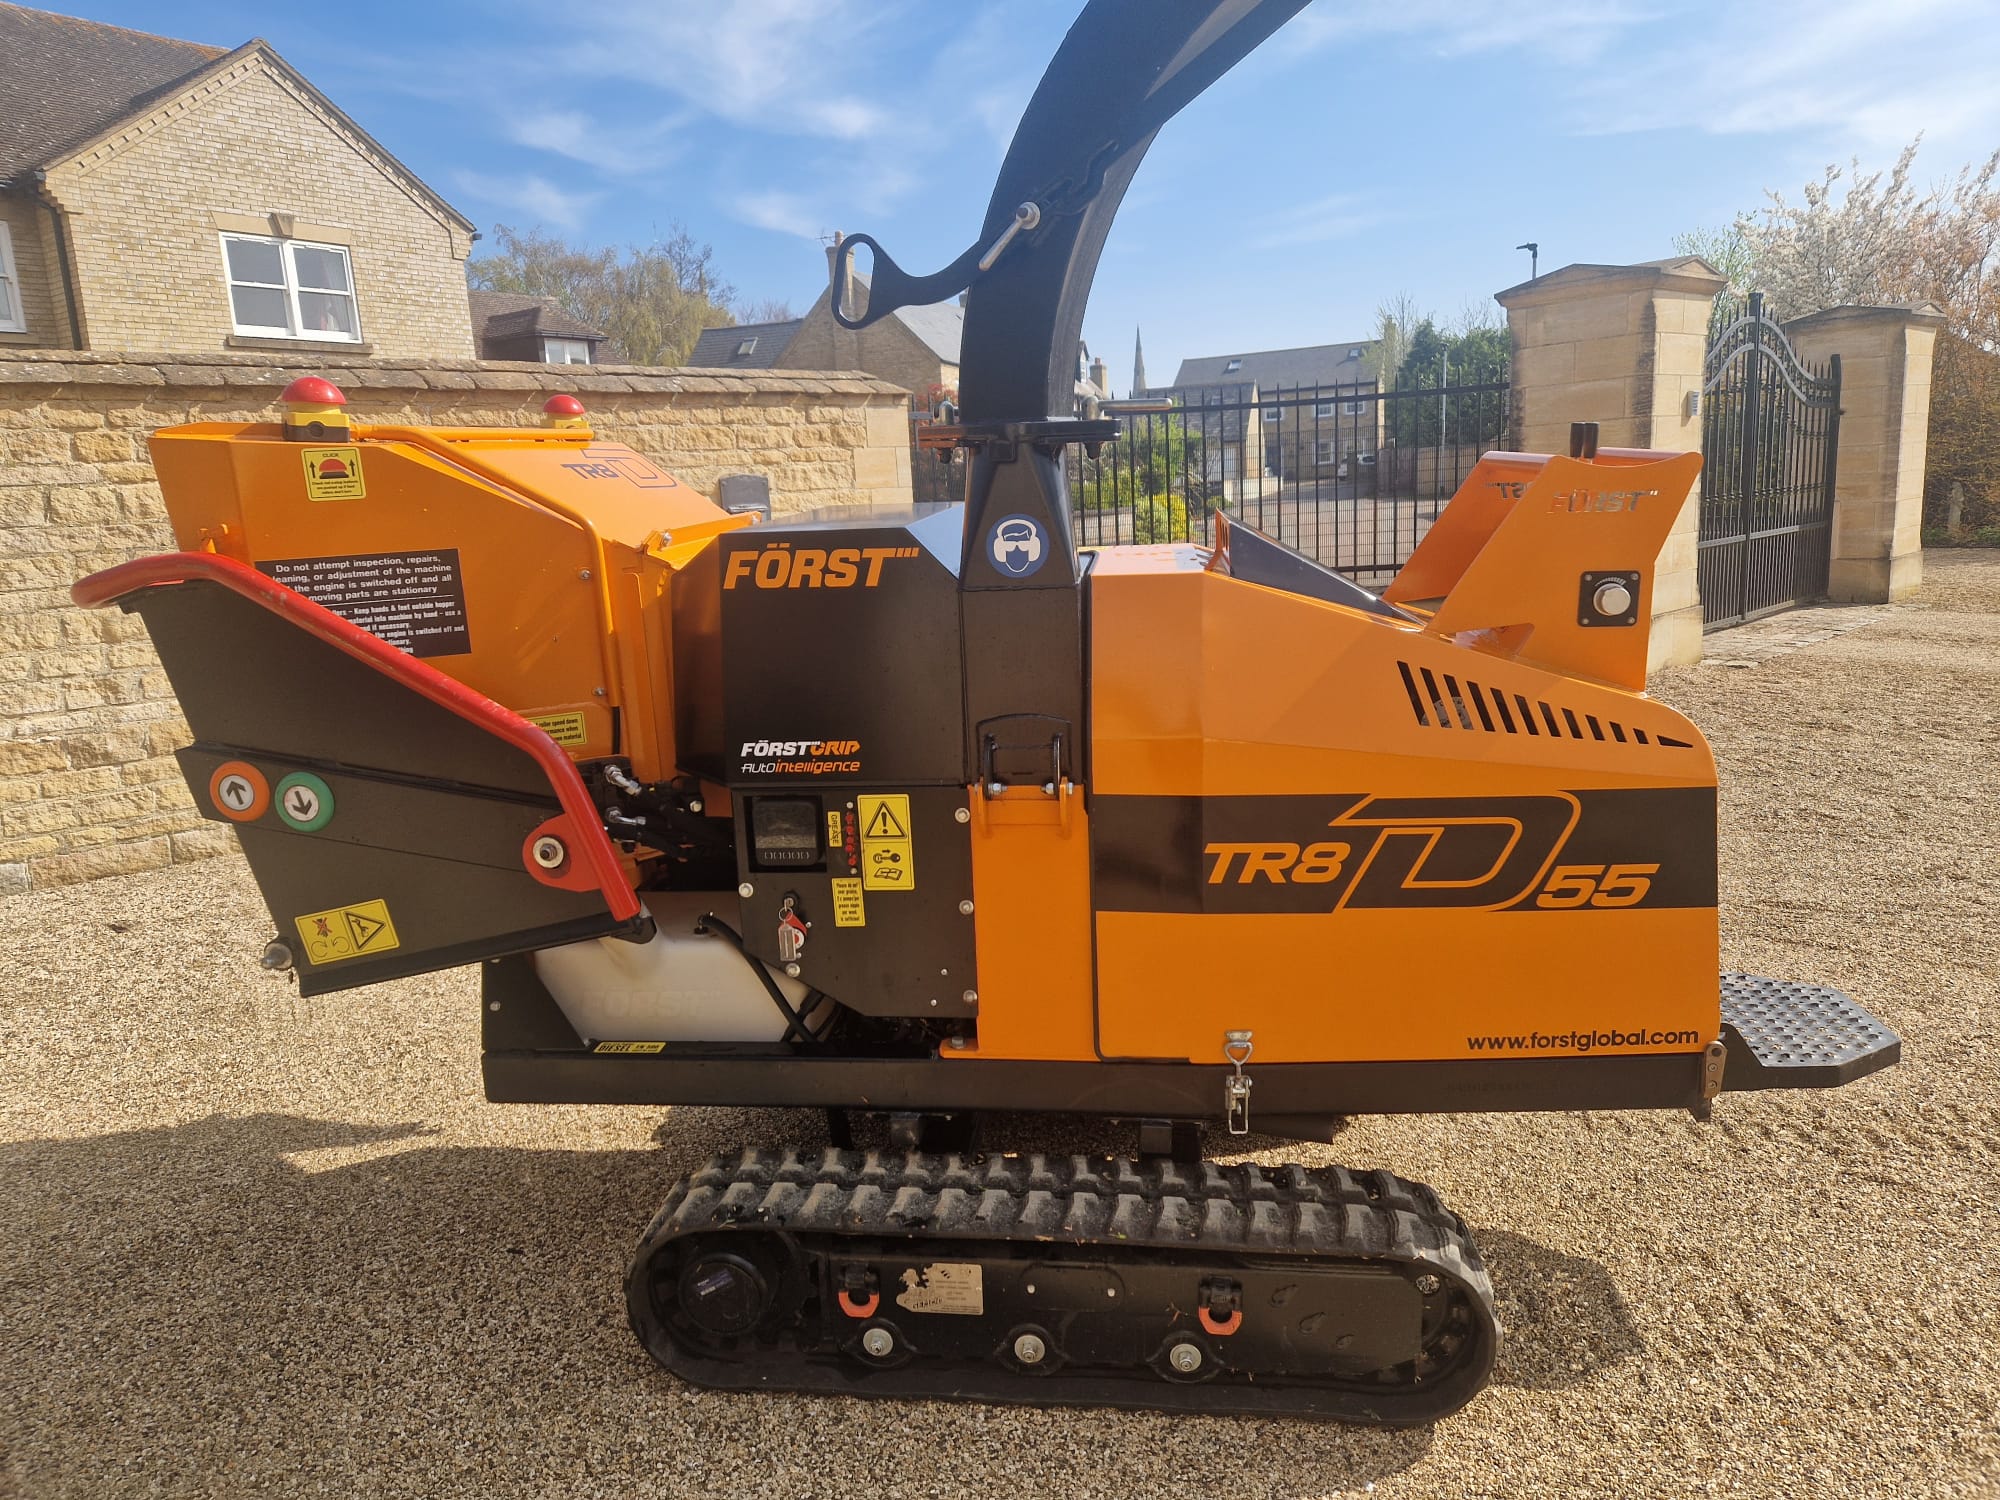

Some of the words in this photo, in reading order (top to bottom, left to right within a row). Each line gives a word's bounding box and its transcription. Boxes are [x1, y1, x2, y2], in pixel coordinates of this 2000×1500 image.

[275, 564, 290, 573] Do
[293, 563, 310, 572] not
[313, 560, 350, 570] attempt
[353, 558, 404, 567] inspection,
[407, 555, 441, 564] repairs,
[272, 574, 310, 583] leaning,
[327, 569, 379, 580] adjustment
[383, 568, 392, 576] of
[414, 565, 452, 573] machine
[314, 582, 346, 592] engine
[360, 578, 402, 588] switched
[405, 576, 418, 584] off
[422, 575, 438, 583] and
[308, 593, 342, 602] moving
[345, 590, 370, 600] parts
[392, 586, 437, 595] stationary
[1204, 842, 1351, 884] TR8
[1536, 863, 1660, 908] 55
[1466, 1029, 1699, 1051] www.forstglobal.com
